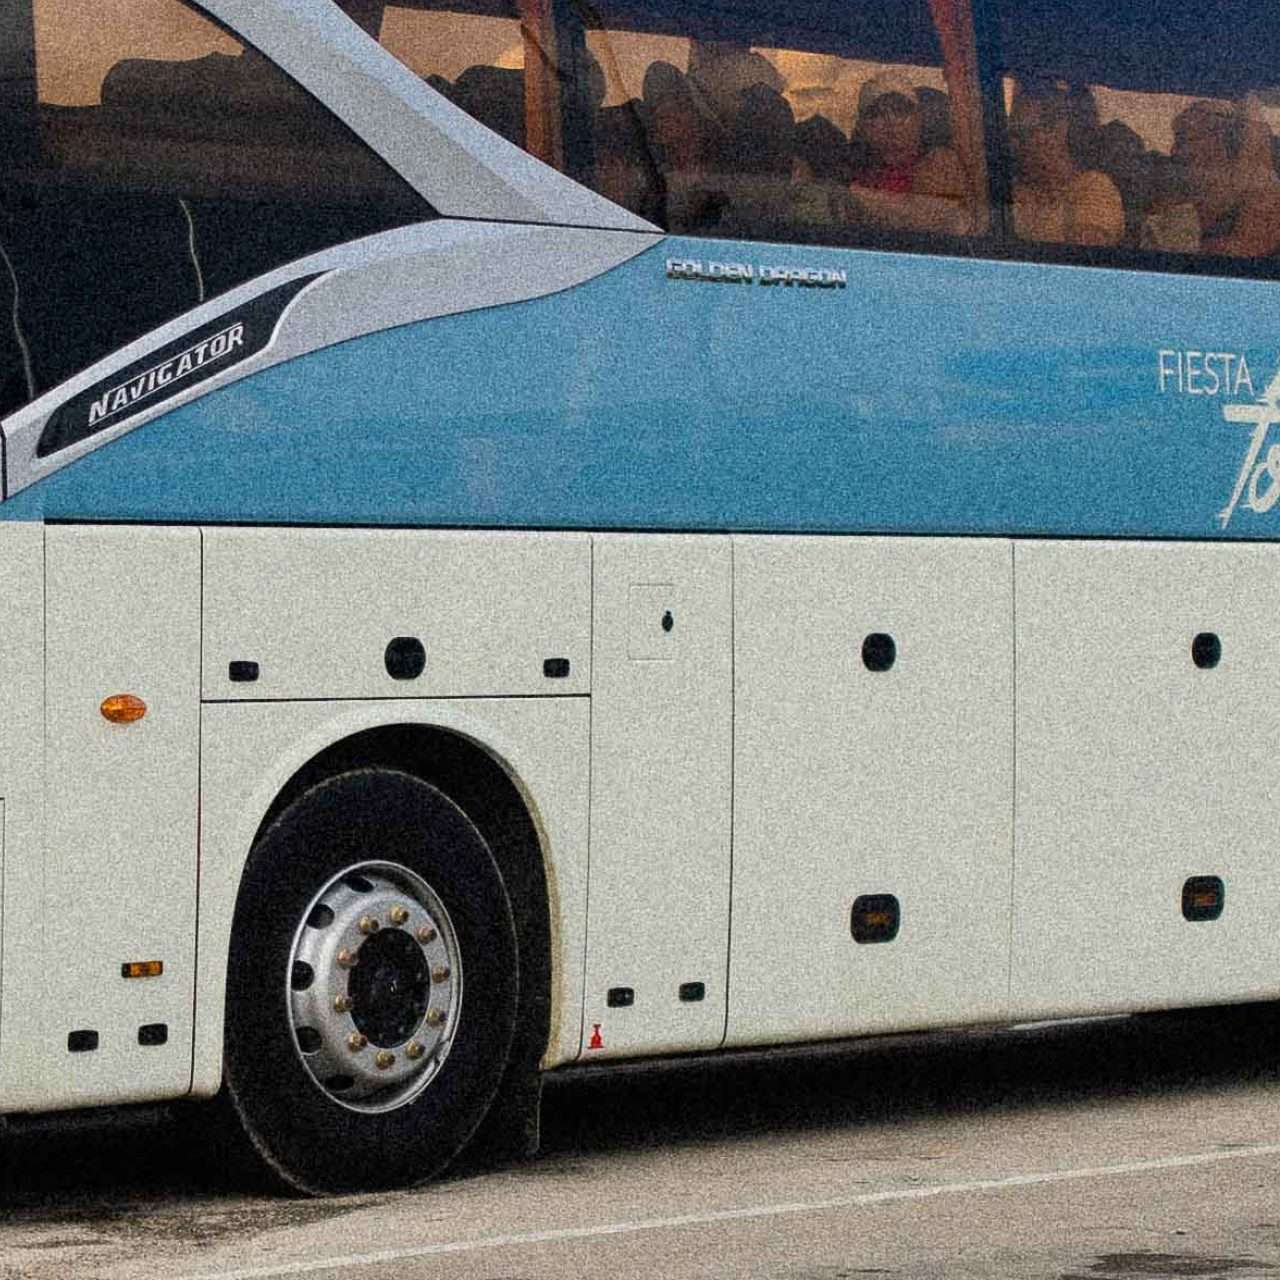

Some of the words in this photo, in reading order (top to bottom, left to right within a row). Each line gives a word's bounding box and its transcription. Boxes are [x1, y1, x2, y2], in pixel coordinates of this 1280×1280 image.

[666, 259, 753, 284] GOLDEN
[759, 264, 848, 288] DRAGON
[87, 322, 245, 427] NAVIGATOR
[1158, 349, 1255, 396] FIESTA
